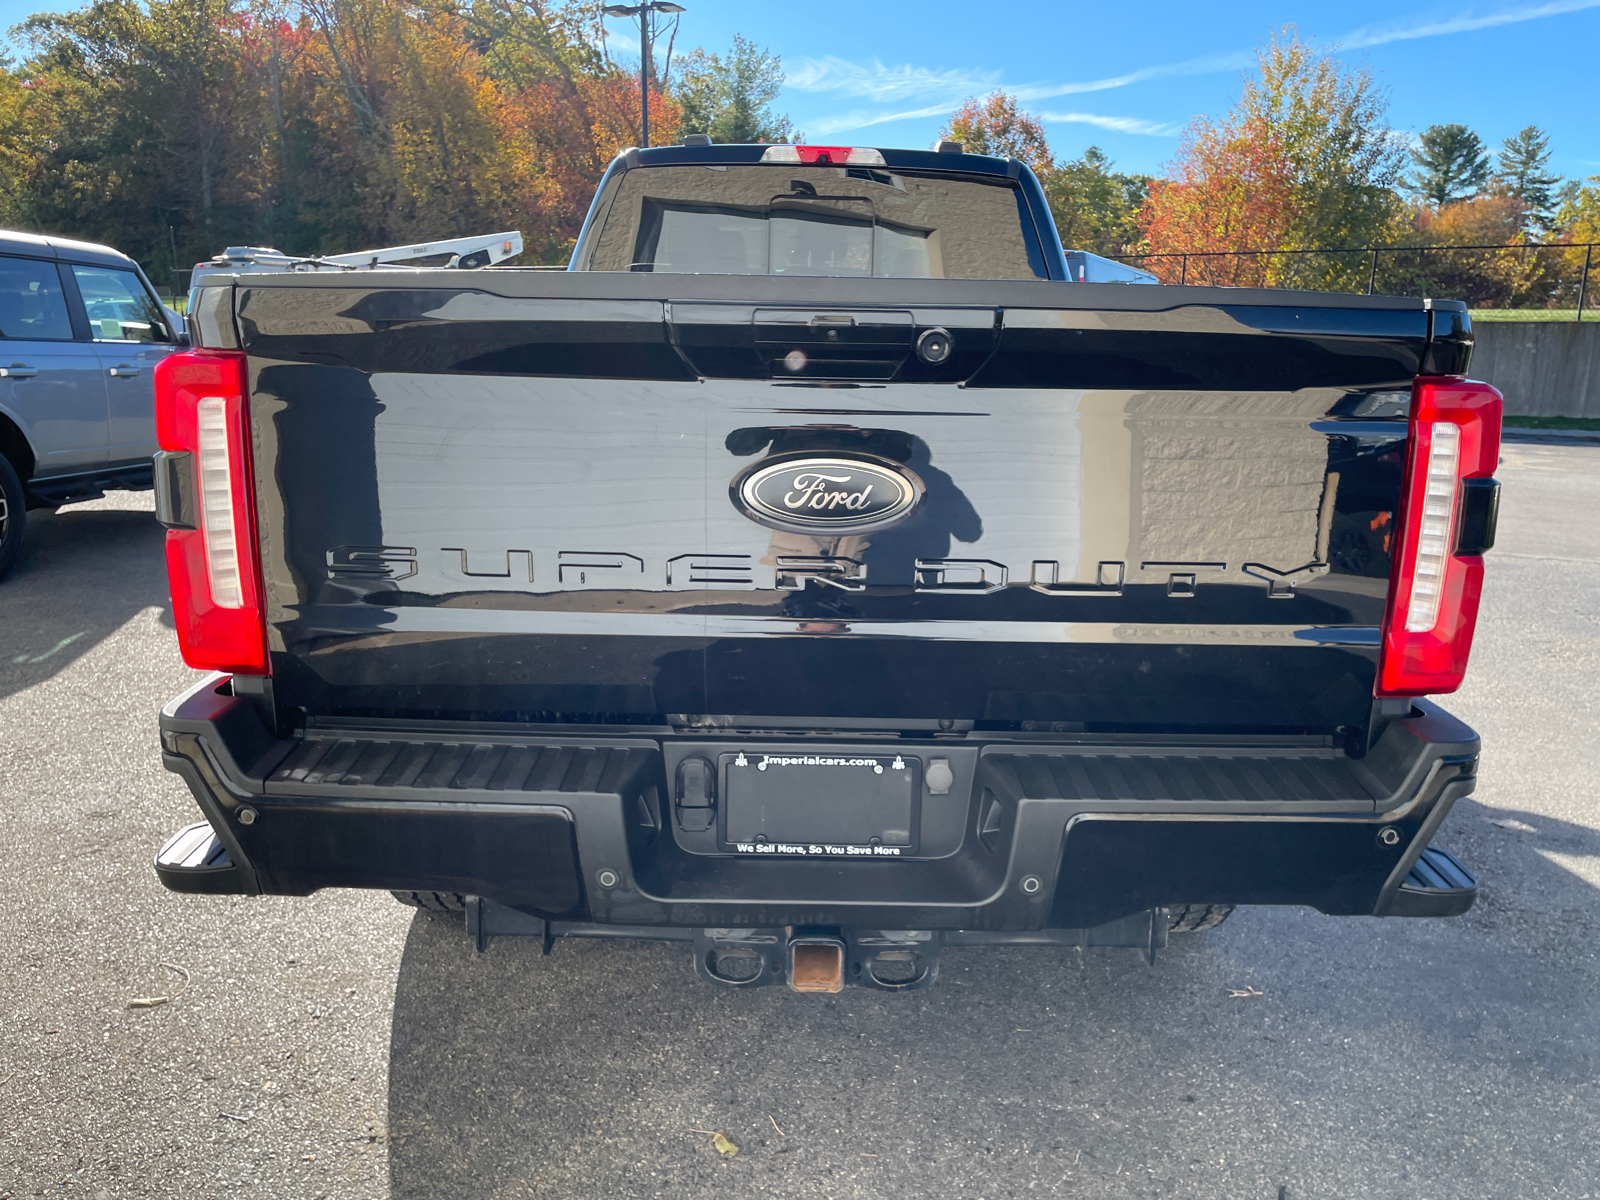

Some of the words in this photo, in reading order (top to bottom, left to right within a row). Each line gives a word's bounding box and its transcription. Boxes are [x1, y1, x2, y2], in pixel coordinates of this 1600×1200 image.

[783, 472, 874, 511] Ford
[325, 544, 868, 593] SUPER
[913, 557, 1331, 599] DUTY
[763, 755, 878, 767] Imperialcars.com
[736, 843, 755, 853] We
[755, 844, 776, 853] Sell
[777, 844, 807, 855] More,
[808, 845, 823, 854] So
[824, 846, 845, 855] You
[846, 846, 872, 855] Save
[873, 846, 901, 856] More
